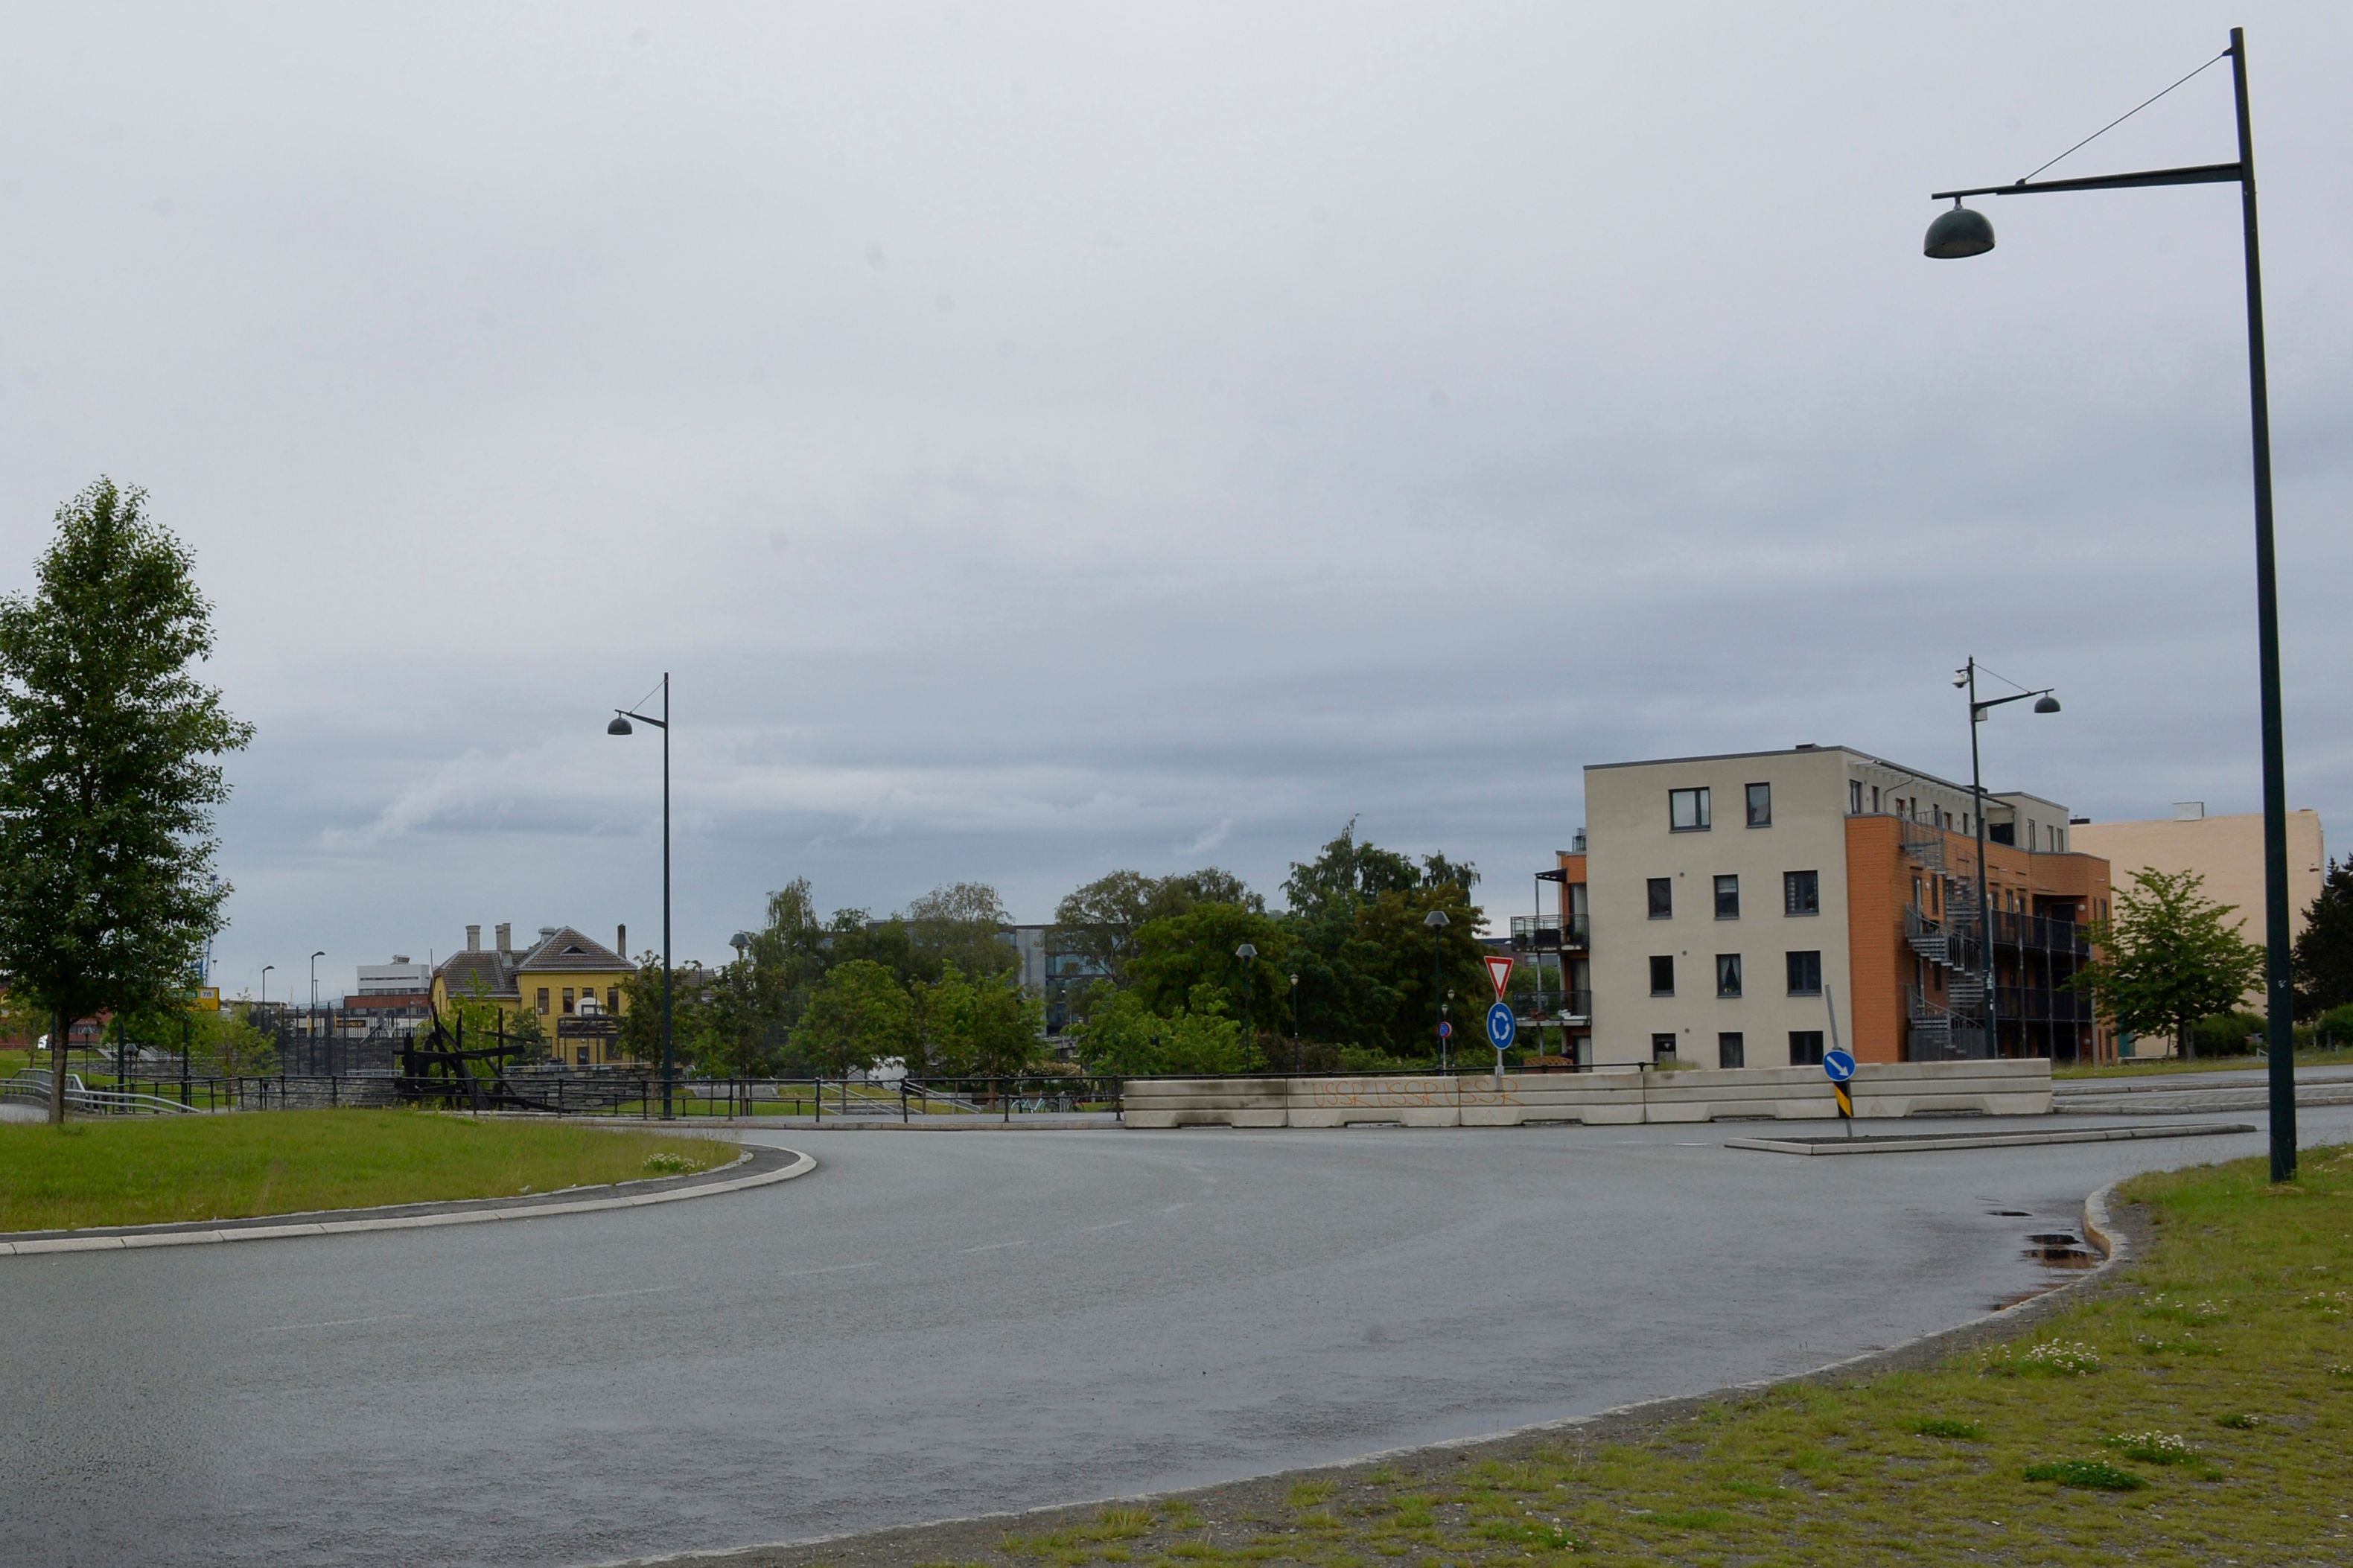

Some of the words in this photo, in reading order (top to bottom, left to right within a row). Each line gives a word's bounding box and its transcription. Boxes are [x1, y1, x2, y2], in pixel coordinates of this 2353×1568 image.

[1312, 1080, 1374, 1108] USSR
[1375, 1080, 1442, 1108] USSR
[1443, 1077, 1525, 1107] USSR
